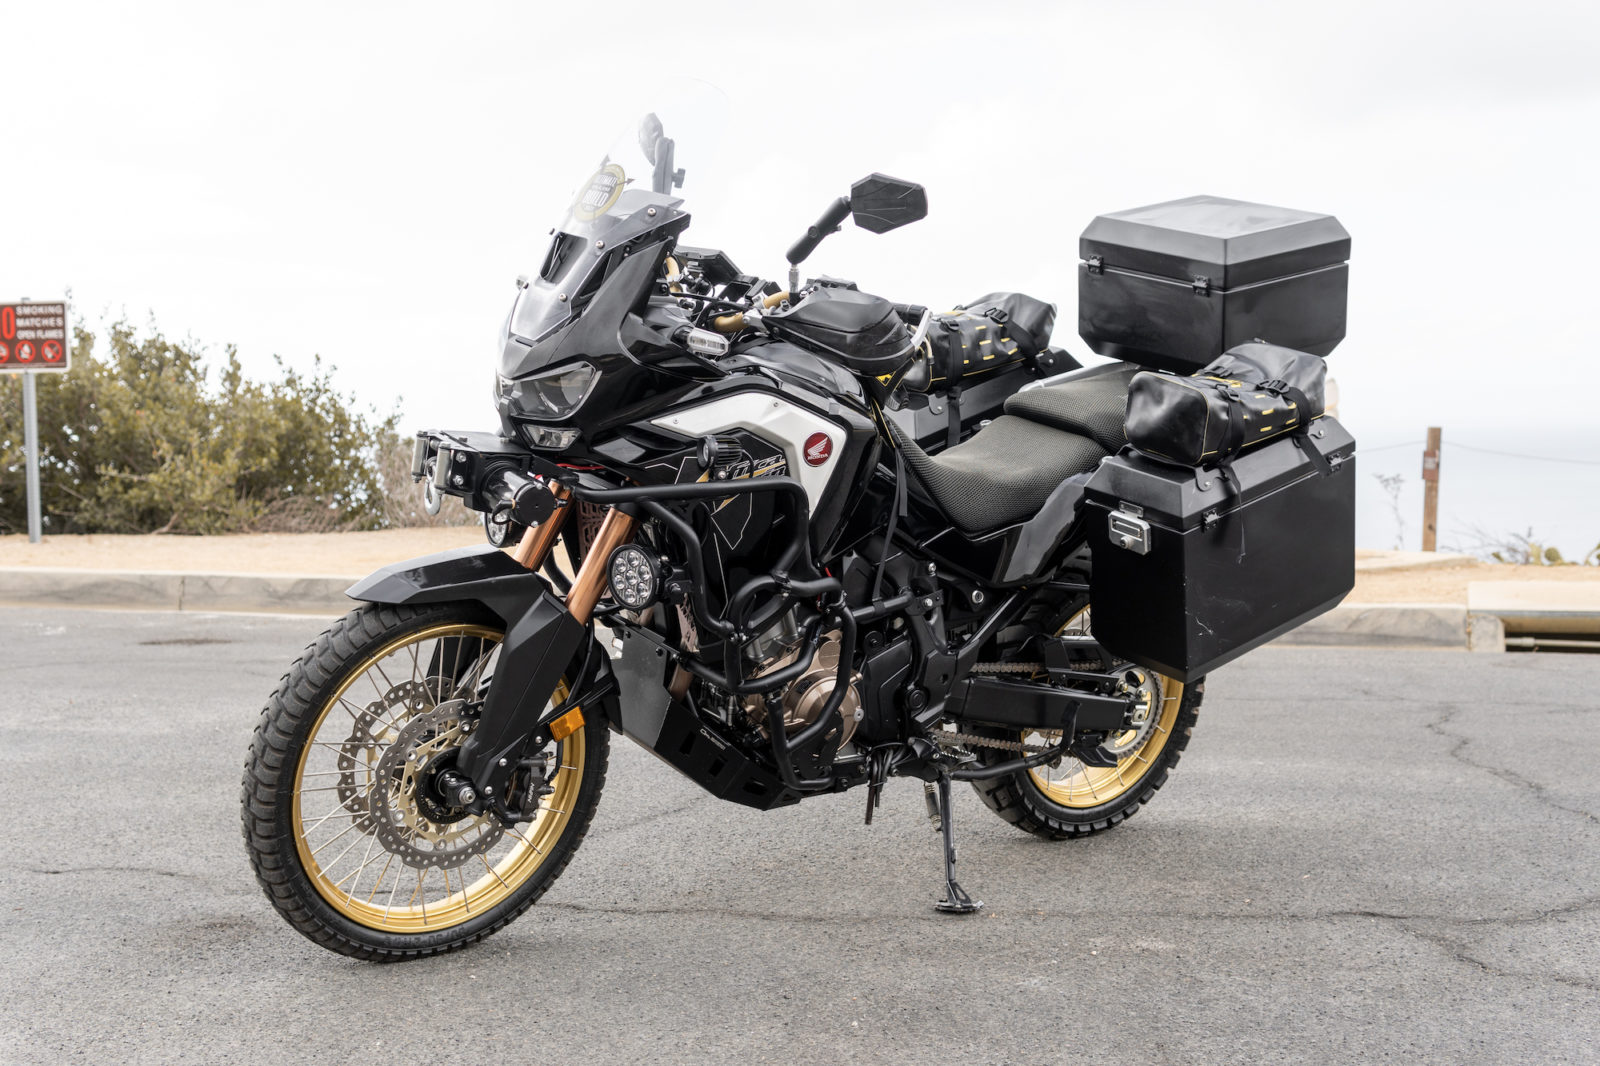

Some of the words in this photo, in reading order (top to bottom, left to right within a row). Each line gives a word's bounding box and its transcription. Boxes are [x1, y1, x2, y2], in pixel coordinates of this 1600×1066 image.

[16, 304, 63, 316] SMOKING
[0, 306, 16, 341] O
[16, 317, 63, 328] MATCHES
[16, 329, 36, 340] OPEN
[807, 453, 828, 461] HONDA
